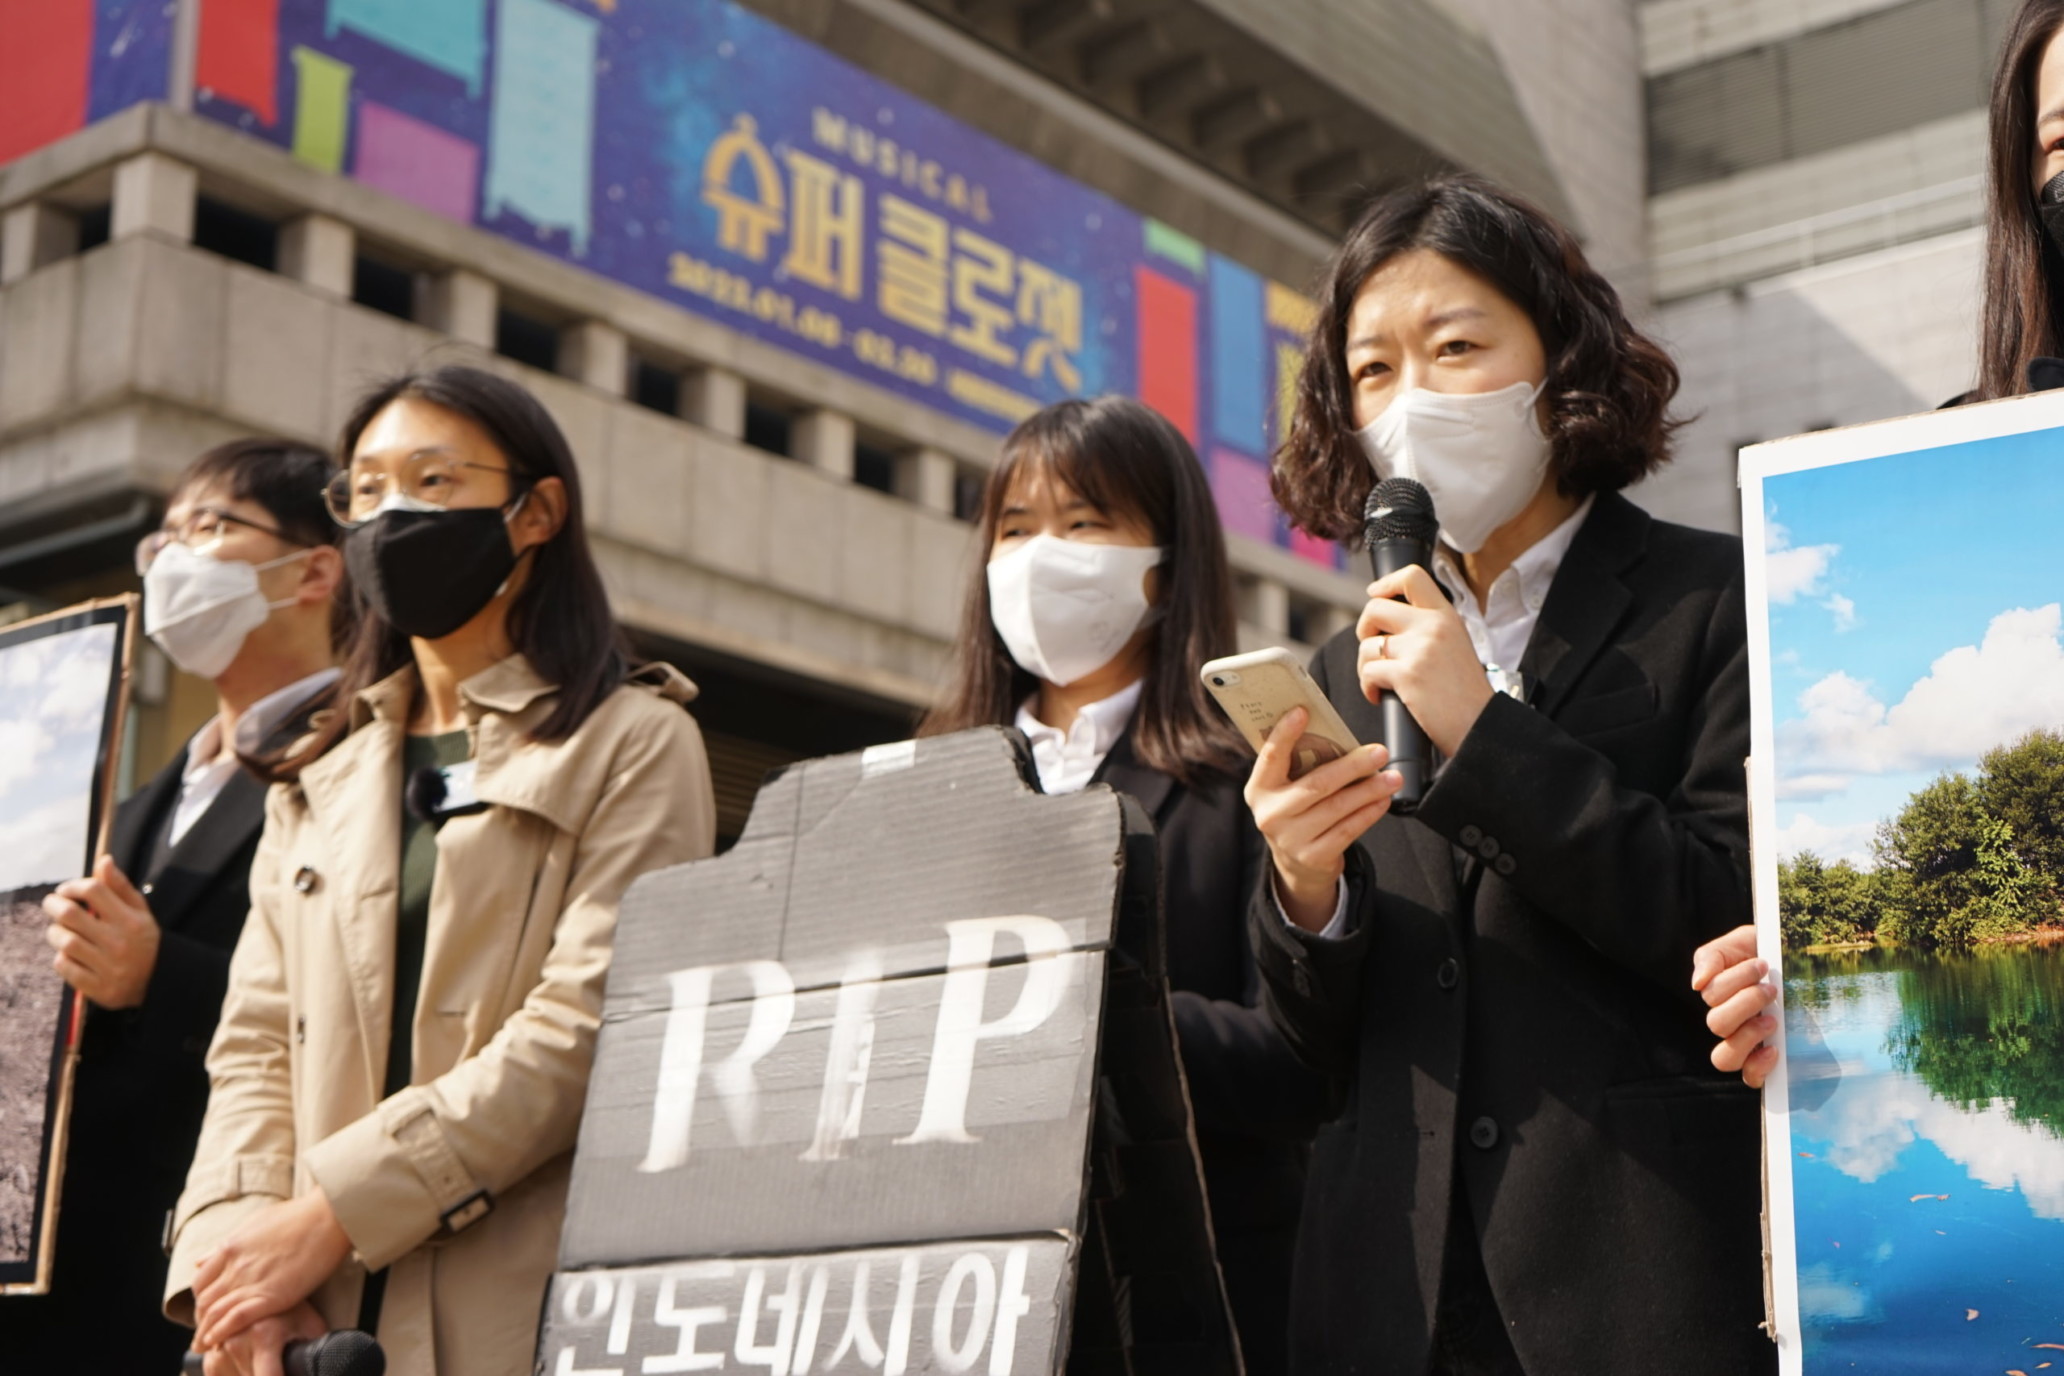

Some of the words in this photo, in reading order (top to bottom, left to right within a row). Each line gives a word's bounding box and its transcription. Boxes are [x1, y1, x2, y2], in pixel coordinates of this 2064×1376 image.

[812, 107, 992, 222] MUSICAL
[637, 914, 1074, 1173] RIP
[555, 1247, 1031, 1376] 인도네시아
